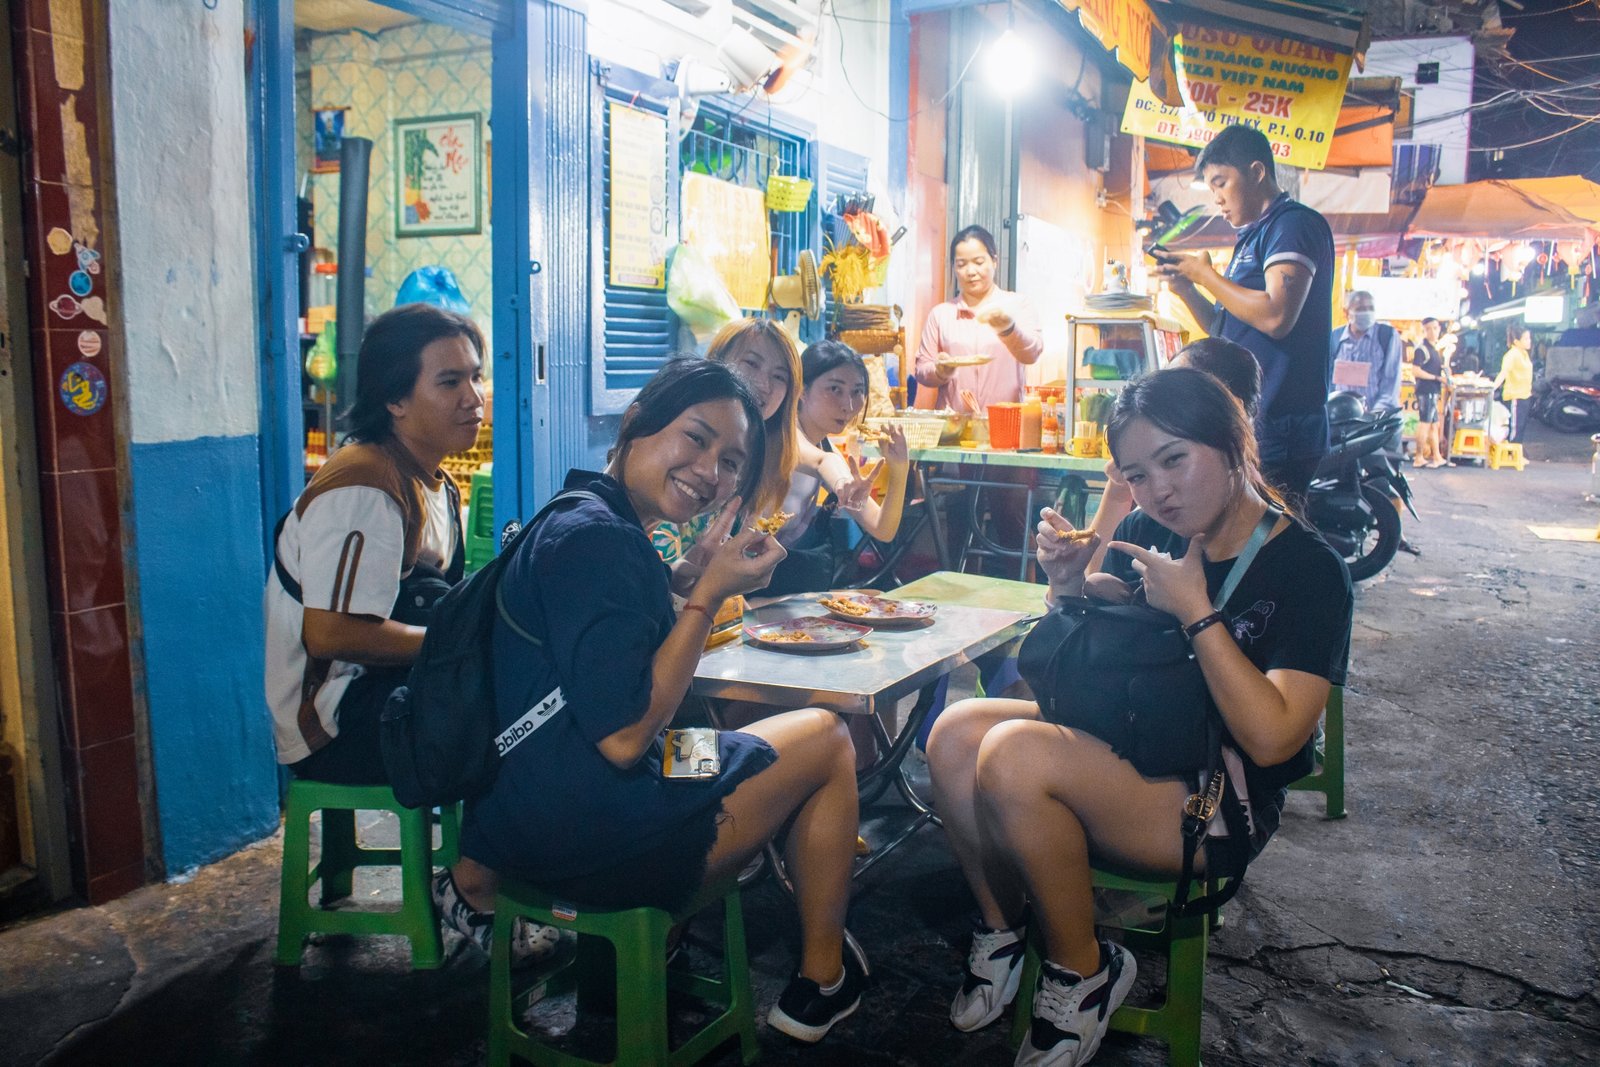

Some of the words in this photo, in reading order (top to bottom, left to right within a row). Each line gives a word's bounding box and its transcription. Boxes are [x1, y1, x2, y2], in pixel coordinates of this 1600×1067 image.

[1262, 76, 1305, 93] NAM
[1185, 80, 1222, 106] 0K
[1243, 91, 1295, 119] 25K
[1294, 127, 1325, 144] Q.10
